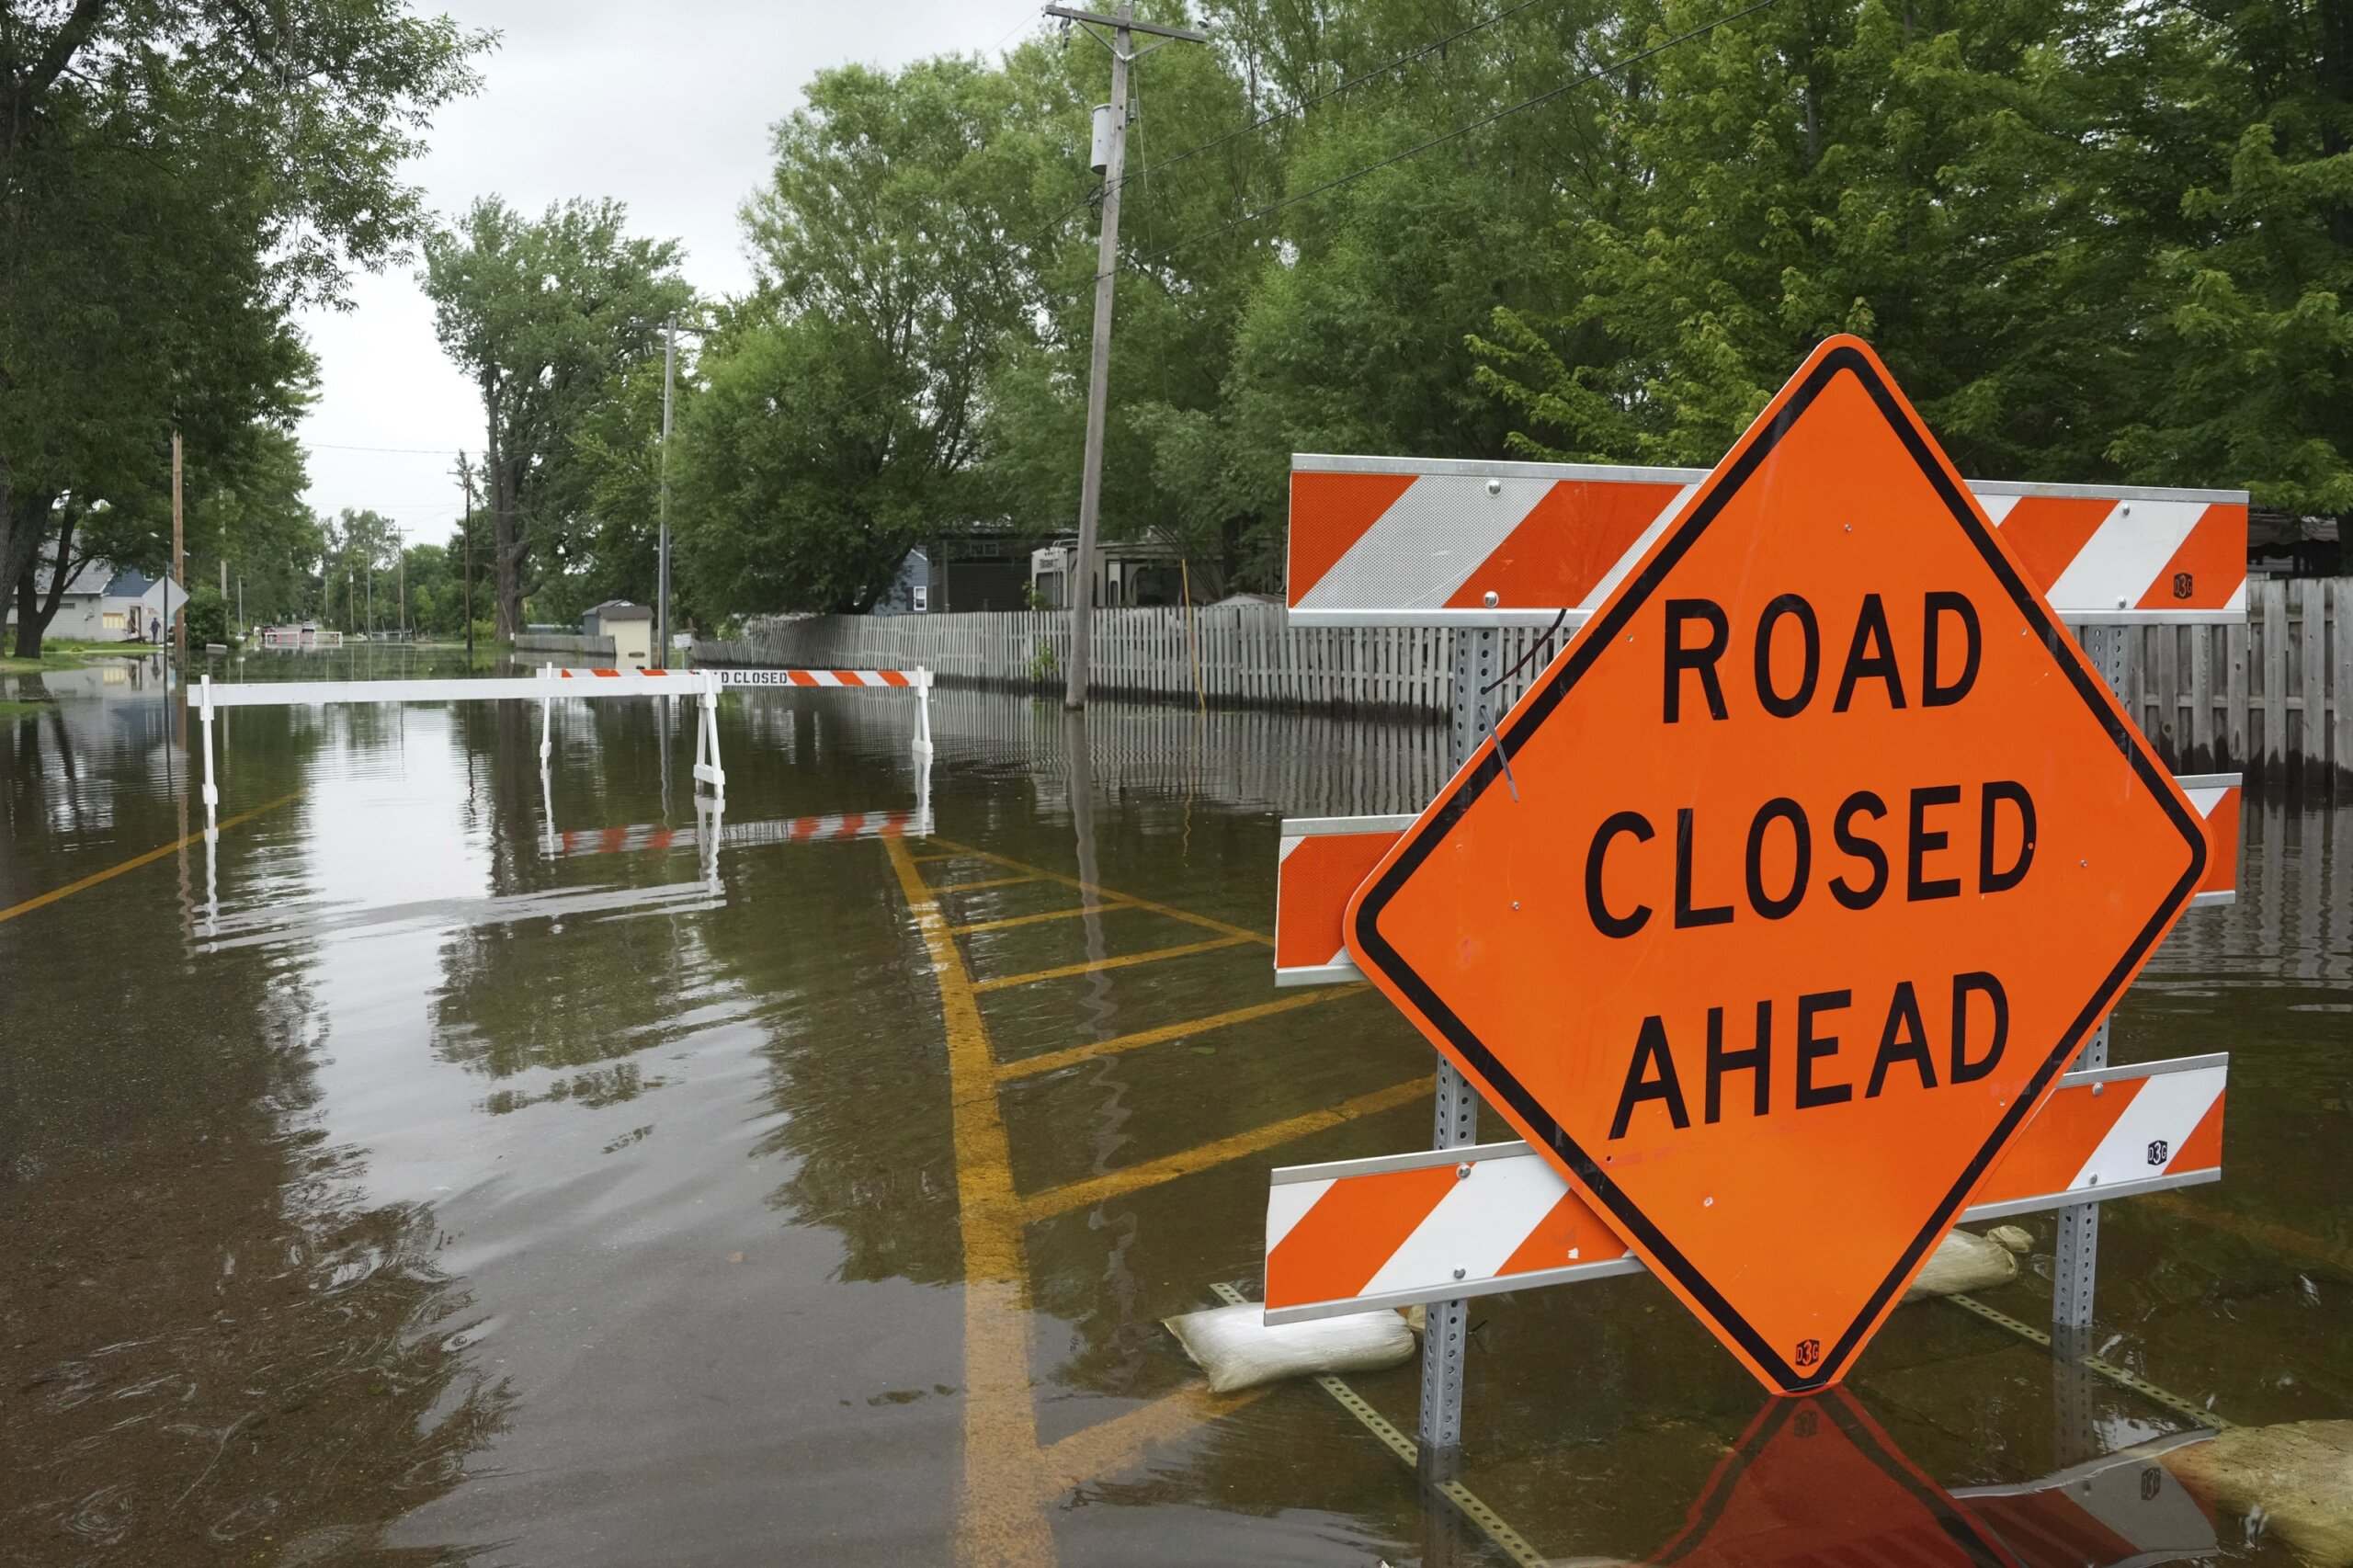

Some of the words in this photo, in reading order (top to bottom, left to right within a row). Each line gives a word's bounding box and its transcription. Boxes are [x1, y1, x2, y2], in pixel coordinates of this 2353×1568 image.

[733, 672, 788, 684] CLOSED
[1664, 592, 1982, 723] ROAD
[1586, 781, 2037, 938] CLOSED
[1608, 971, 2009, 1141] AHEAD
[2148, 1141, 2167, 1165] D3G
[1796, 1340, 1819, 1366] D3G
